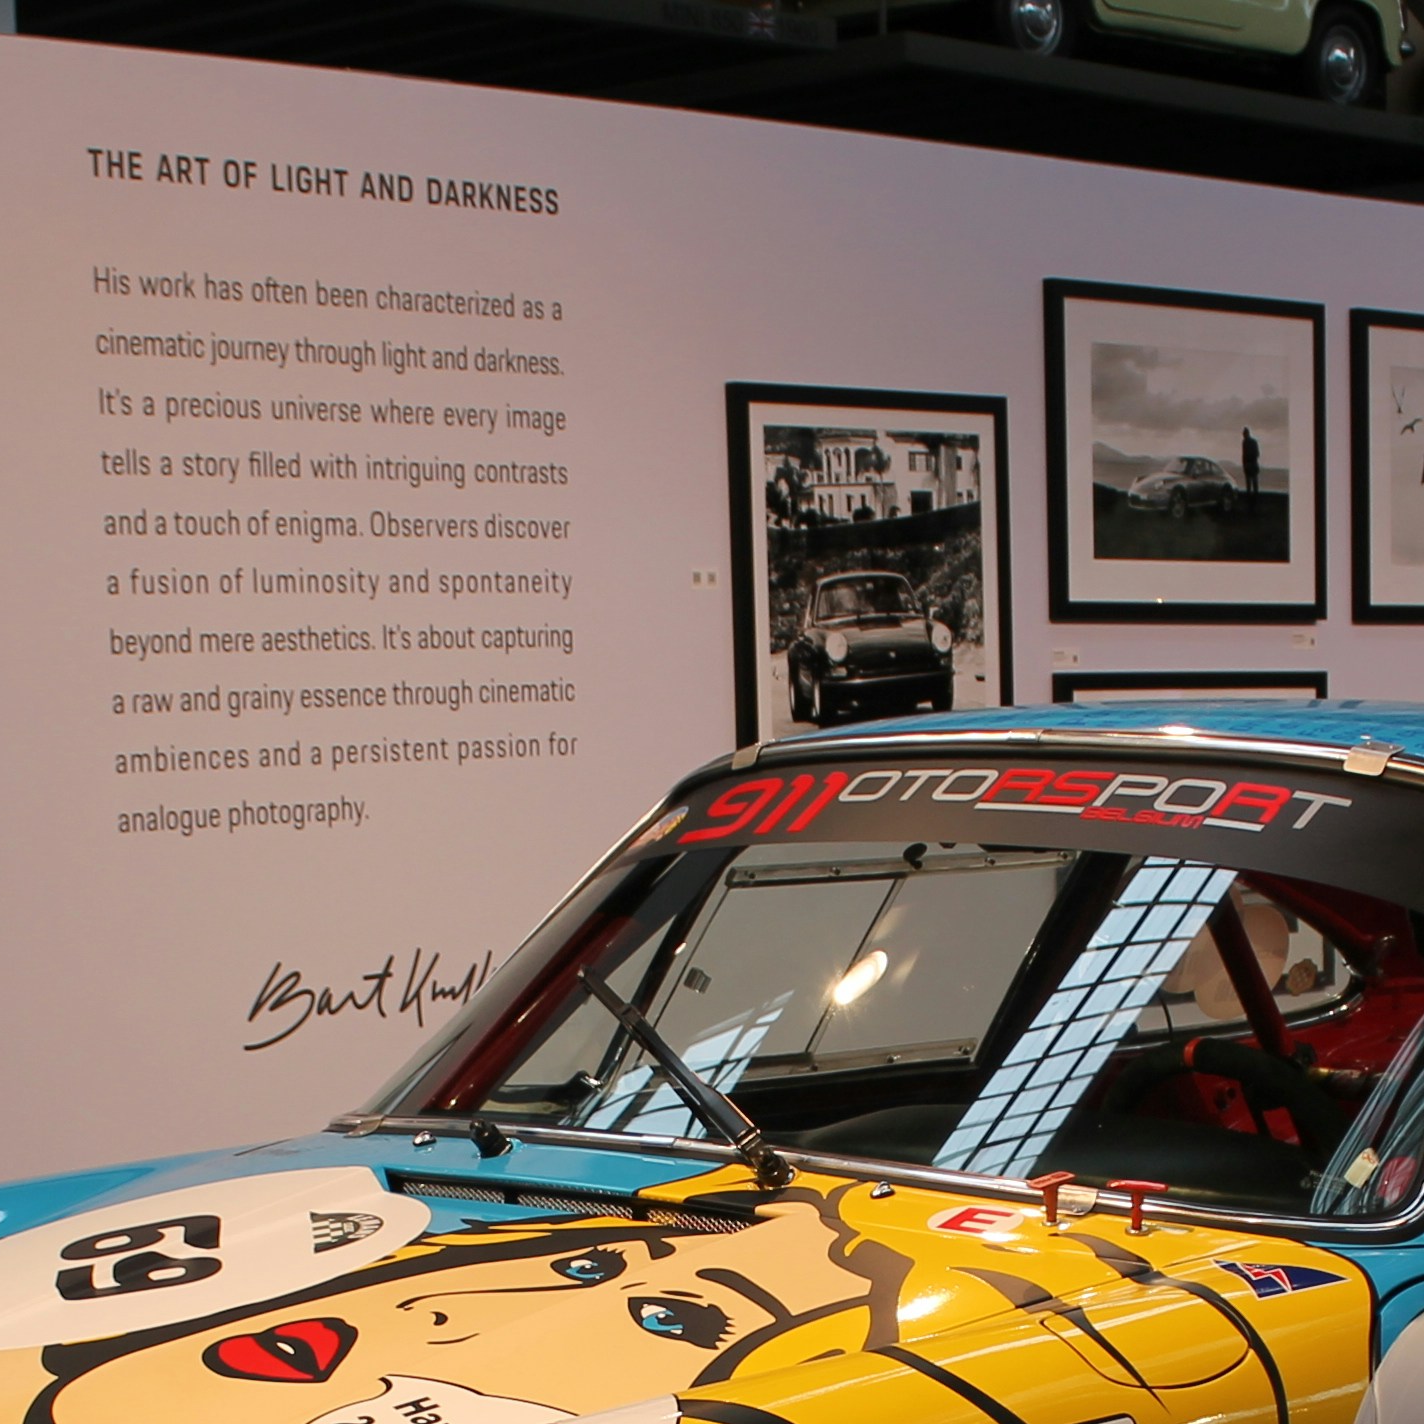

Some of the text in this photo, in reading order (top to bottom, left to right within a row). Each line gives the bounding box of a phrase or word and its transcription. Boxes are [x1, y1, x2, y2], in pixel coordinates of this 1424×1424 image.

[86, 147, 559, 216] THE ART OF LIGHT AND DARKNESS
[93, 266, 563, 322] His work has often been characterized as a
[95, 327, 565, 376] cinematic journey through light and darkness.
[99, 387, 567, 438] It's a precious universe where every image
[100, 448, 569, 490] tells a story filled with intriguing contrasts
[104, 508, 571, 544] and a touch of enigma. Observers discover
[106, 567, 572, 601] a fusion of luminosity and spontaneity
[109, 623, 574, 662] beyond mere aesthetics. It's about capturing
[112, 677, 576, 719] a raw and grainy essence through cinematic
[115, 731, 578, 775] ambiences and a persistent passion for
[118, 795, 369, 837] analogue photography.
[1079, 806, 1205, 830] BELGIUM
[243, 954, 395, 1051] Bart
[939, 1206, 1015, 1234] E
